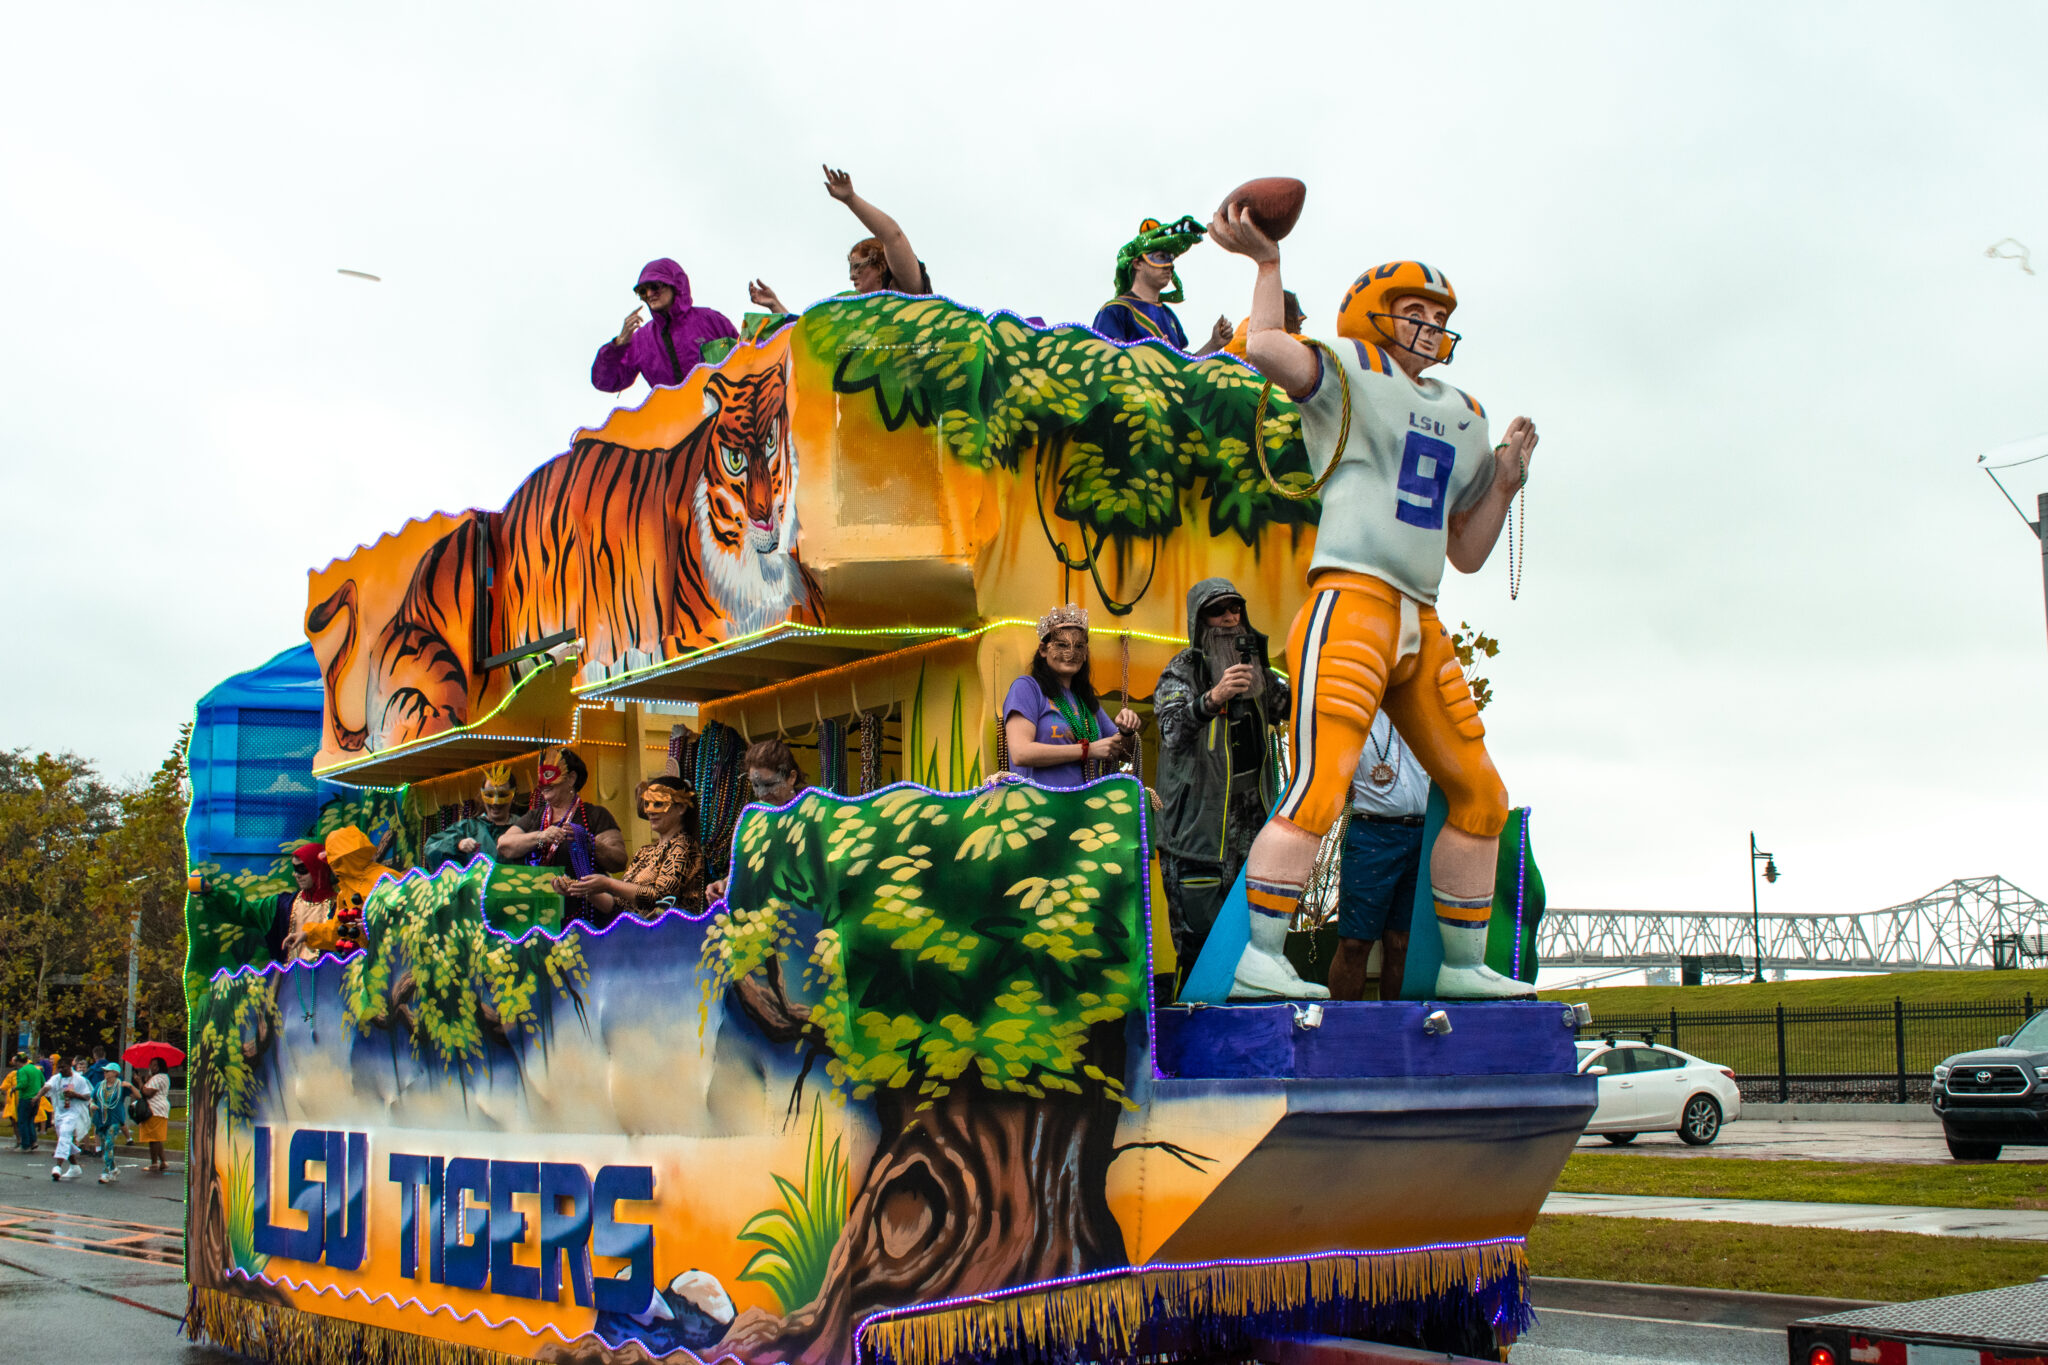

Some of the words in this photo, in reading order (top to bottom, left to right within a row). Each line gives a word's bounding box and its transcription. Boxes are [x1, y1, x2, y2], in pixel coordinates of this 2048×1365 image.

[1409, 411, 1445, 436] LSU
[1395, 430, 1456, 530] 9
[253, 1126, 368, 1271] LSU
[389, 1152, 655, 1315] TIGERS
